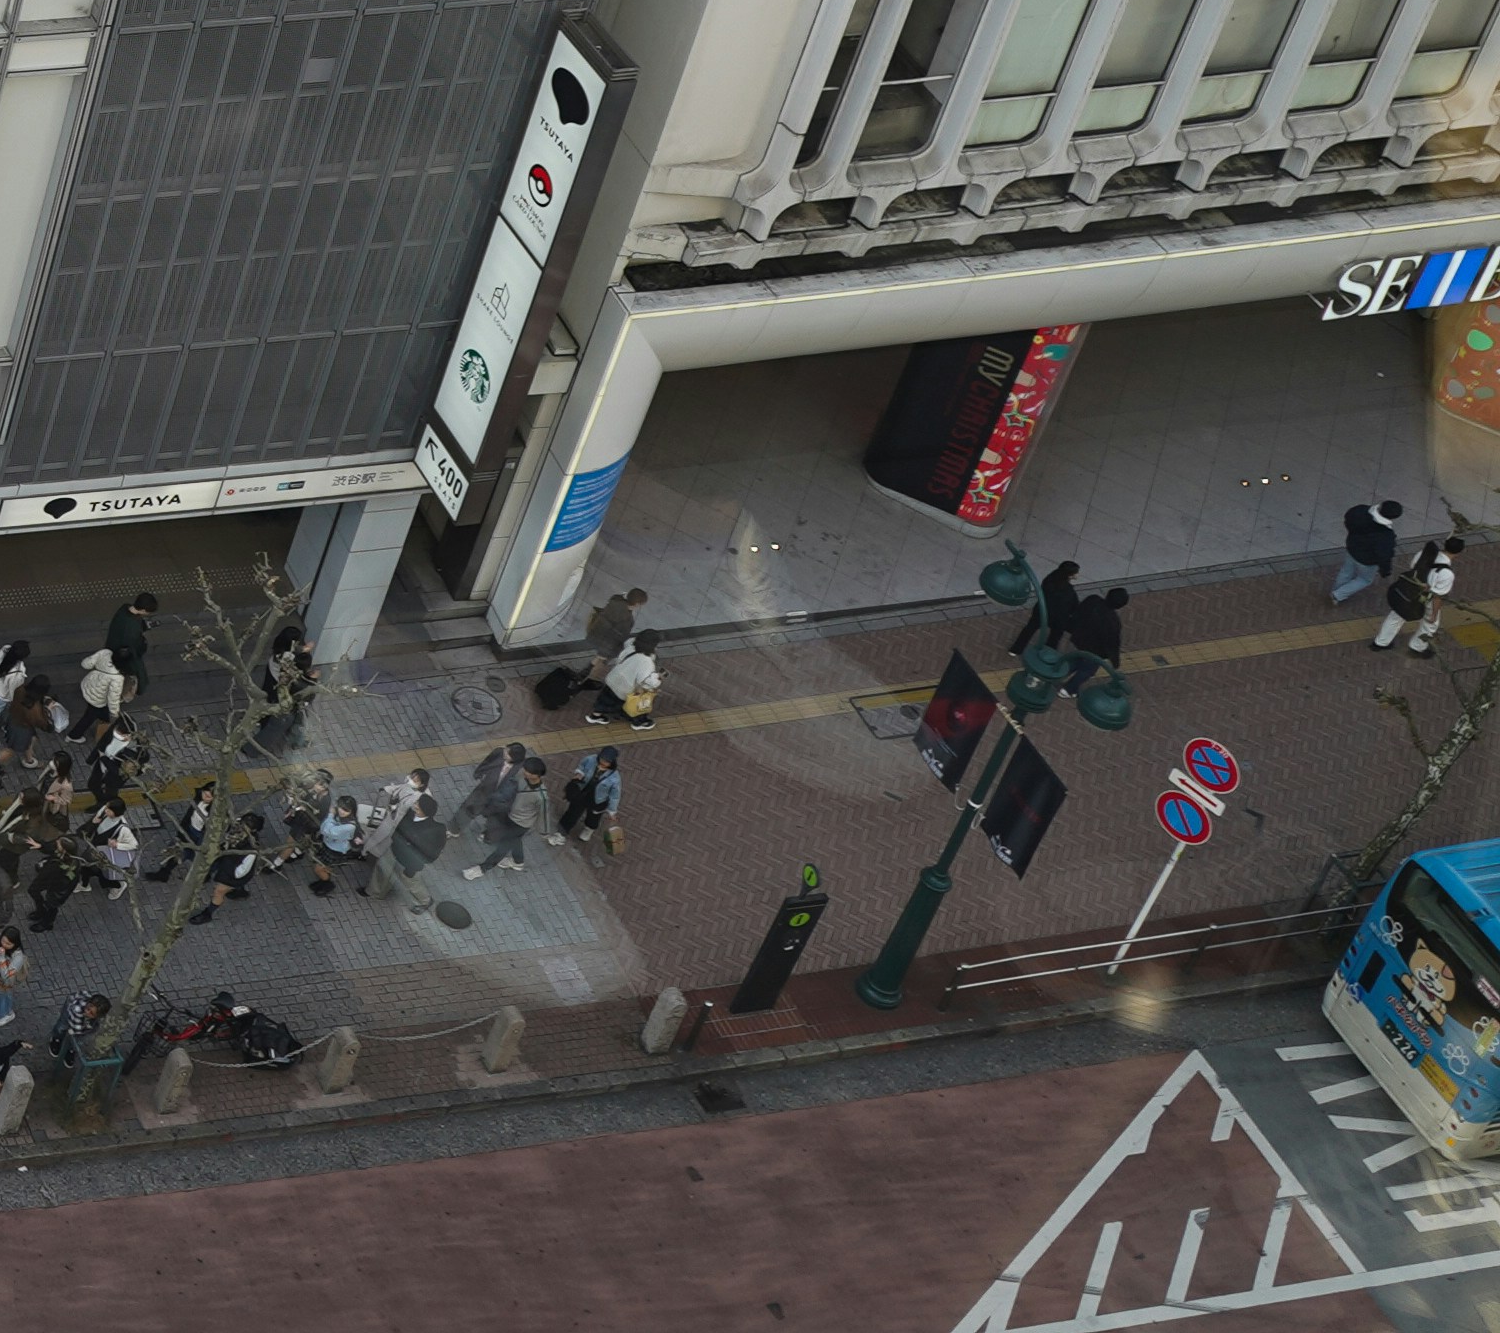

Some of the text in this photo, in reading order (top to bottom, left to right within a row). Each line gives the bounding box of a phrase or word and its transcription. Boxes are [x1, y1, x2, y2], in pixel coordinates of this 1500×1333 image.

[540, 115, 575, 164] TSUTAYA
[331, 471, 377, 488] 渋谷駅
[432, 474, 457, 513] SEATS
[437, 456, 464, 501] 400
[88, 493, 182, 513] TSUTAYA
